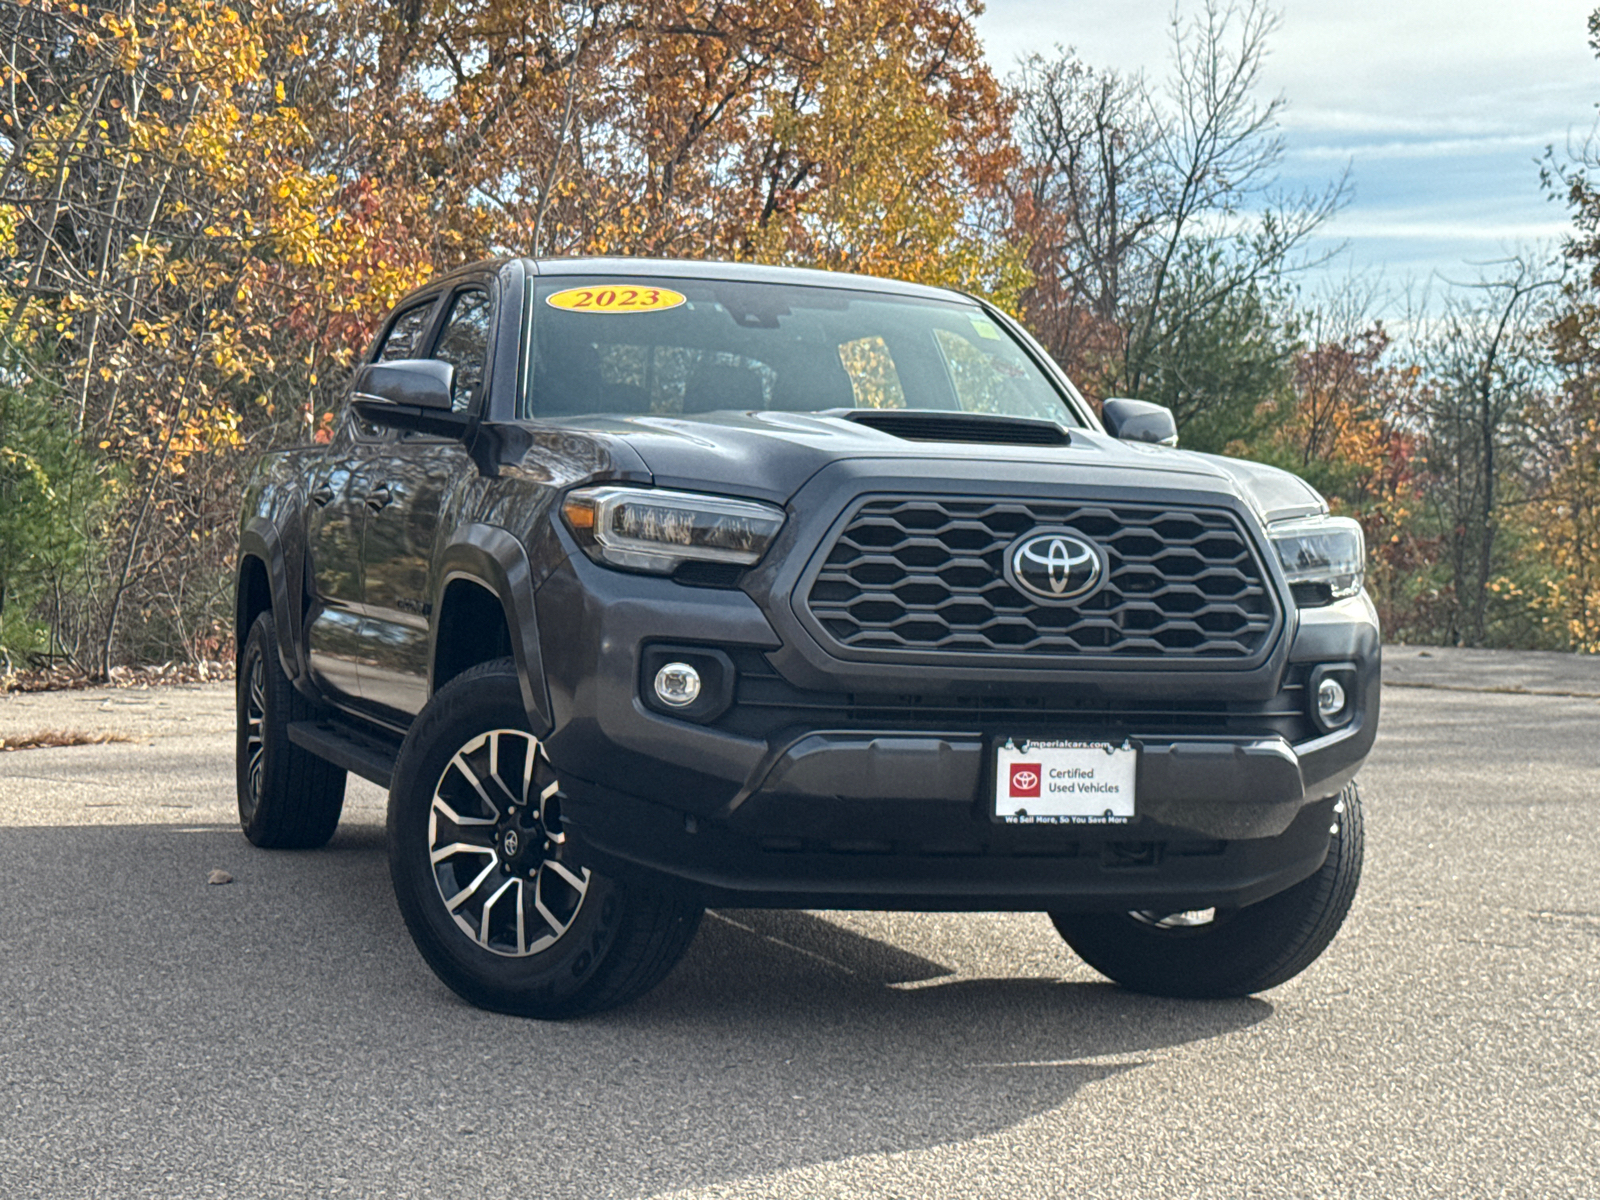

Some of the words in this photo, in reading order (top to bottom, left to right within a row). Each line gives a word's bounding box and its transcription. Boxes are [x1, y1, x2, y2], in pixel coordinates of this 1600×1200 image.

[572, 290, 660, 308] 2023
[1026, 739, 1111, 749] Imperialcars.com
[1049, 768, 1094, 779] Certified
[1049, 783, 1075, 793] Used
[1077, 783, 1119, 793] Vehicles
[1005, 816, 1018, 824] We
[1020, 816, 1034, 824] Sell
[1036, 816, 1058, 825] More,
[1060, 816, 1070, 824] So
[1071, 816, 1086, 824] You
[1087, 816, 1106, 824] Save
[1107, 816, 1127, 824] More
